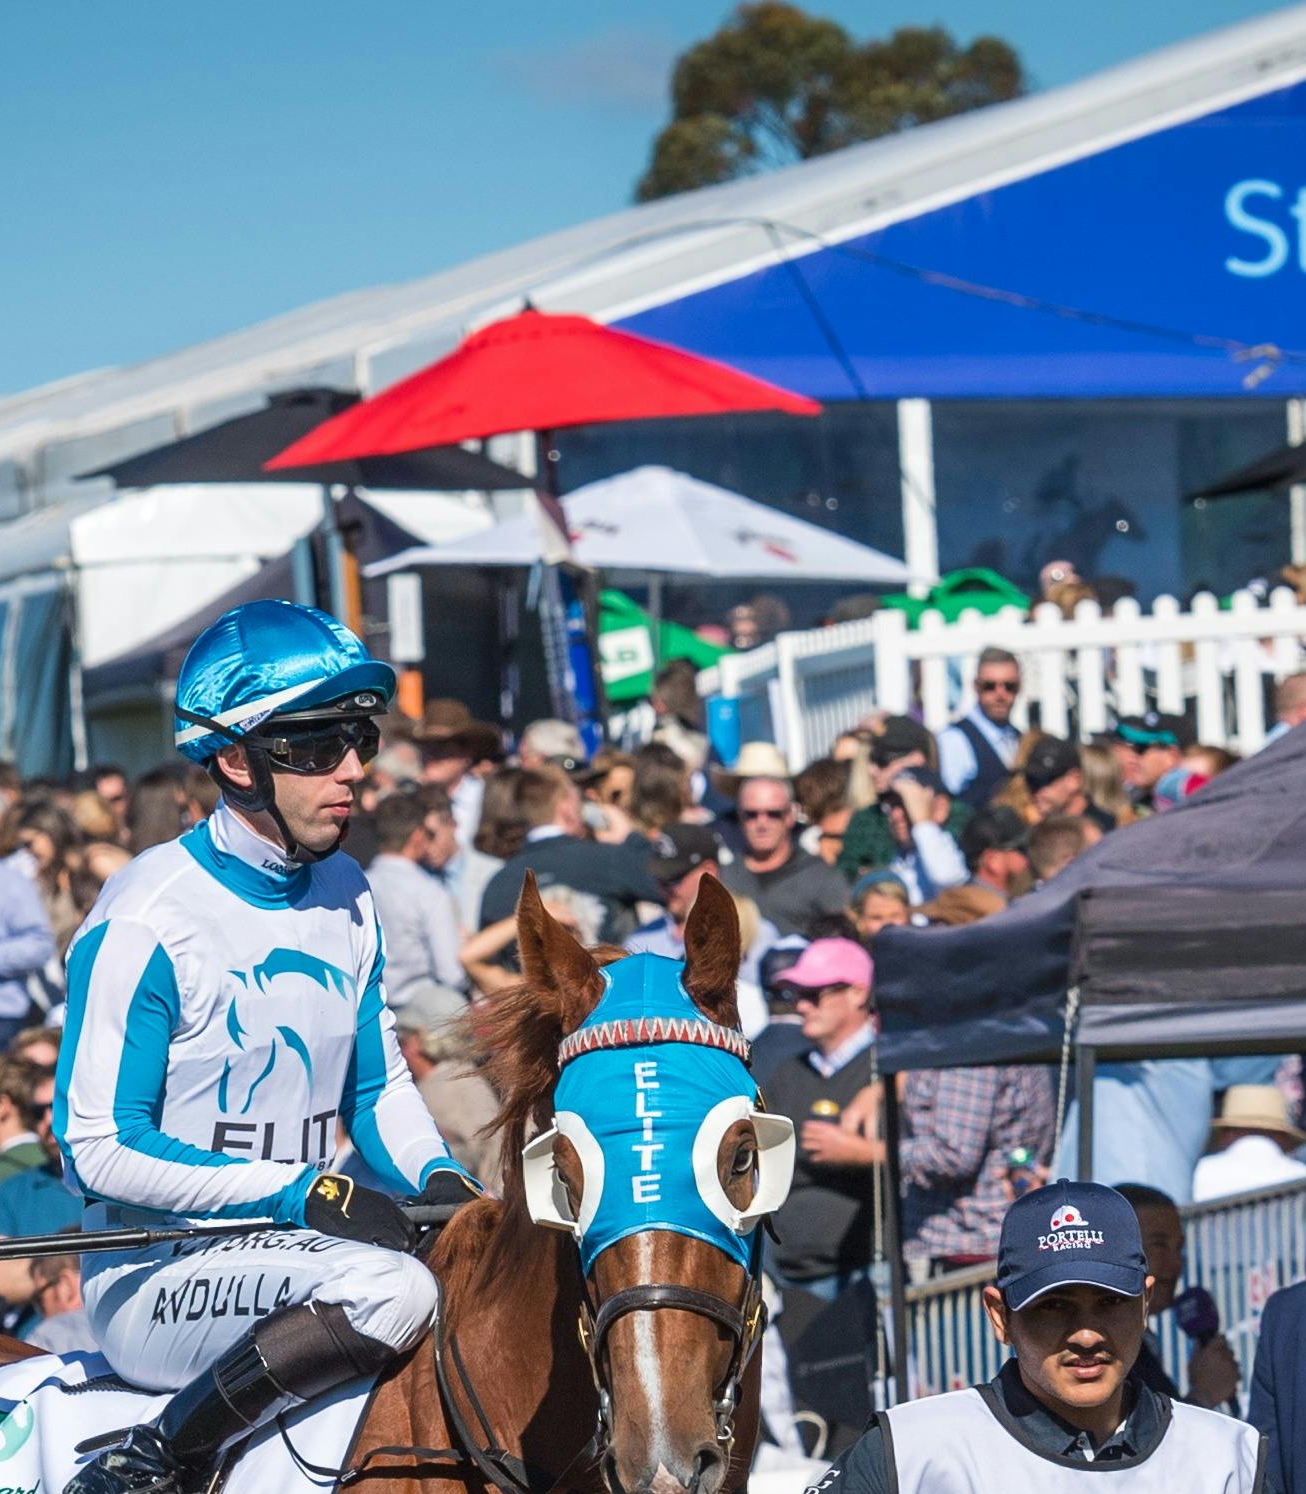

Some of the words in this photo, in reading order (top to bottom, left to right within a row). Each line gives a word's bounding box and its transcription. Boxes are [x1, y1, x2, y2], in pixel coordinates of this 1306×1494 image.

[631, 1061, 664, 1204] ELITE
[1037, 1229, 1104, 1250] PORTELLI
[150, 1273, 292, 1325] AVDULLA
